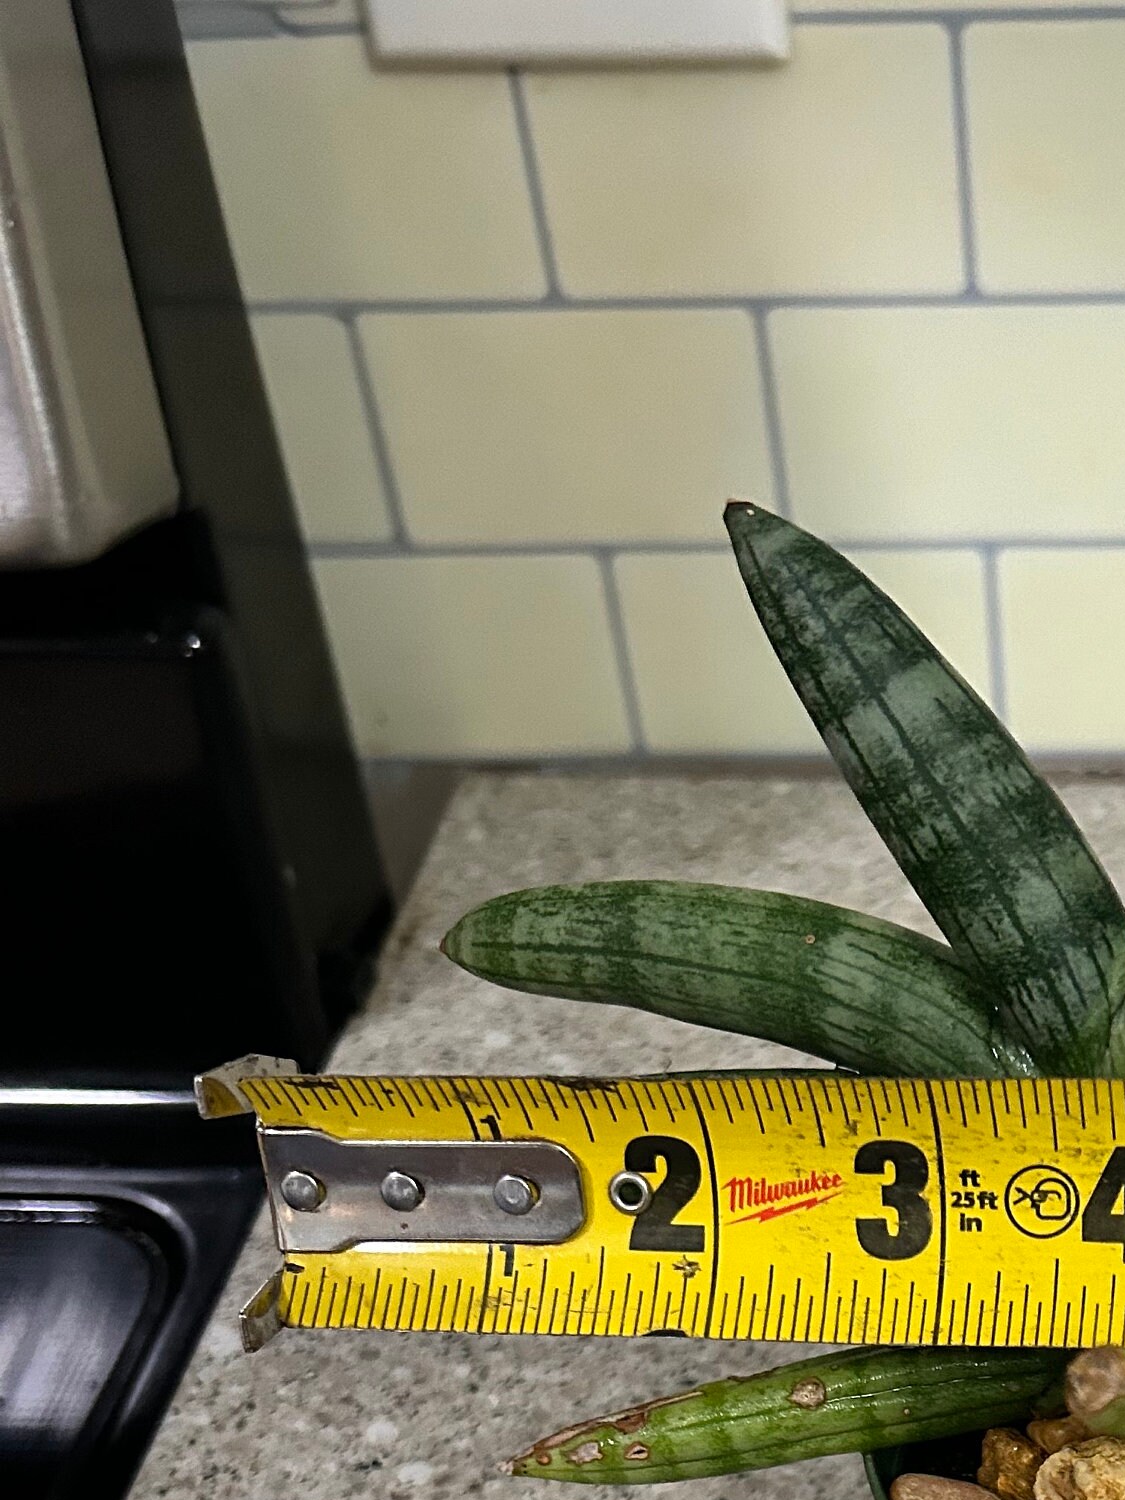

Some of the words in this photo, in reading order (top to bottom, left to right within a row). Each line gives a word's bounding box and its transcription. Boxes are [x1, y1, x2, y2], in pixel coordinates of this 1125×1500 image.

[622, 1134, 705, 1253] 2
[721, 1169, 848, 1213] Milwaukee
[853, 1139, 934, 1262] 3
[958, 1168, 982, 1189] ft
[959, 1213, 983, 1233] in
